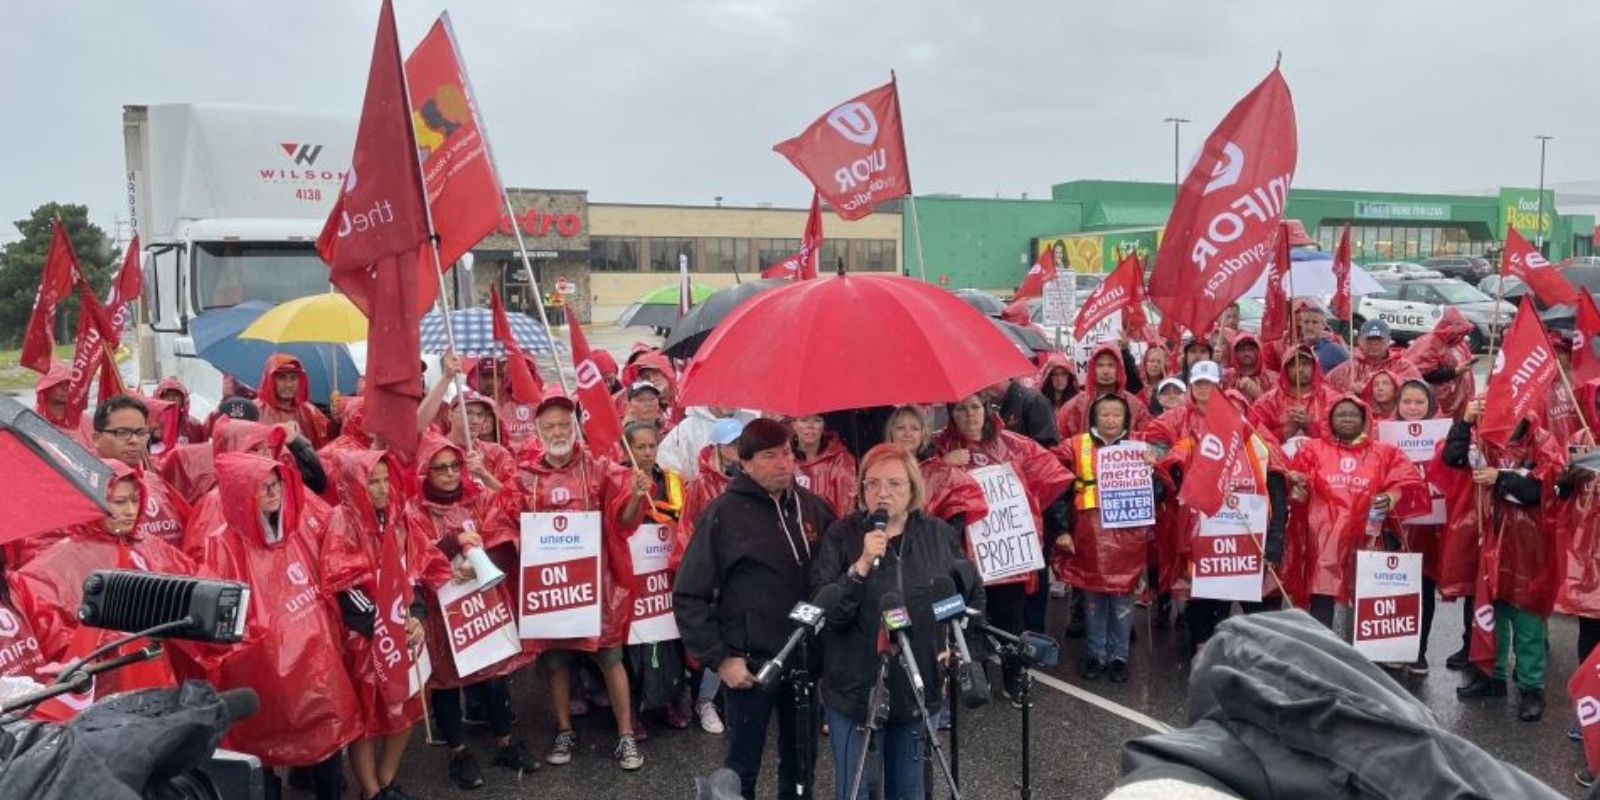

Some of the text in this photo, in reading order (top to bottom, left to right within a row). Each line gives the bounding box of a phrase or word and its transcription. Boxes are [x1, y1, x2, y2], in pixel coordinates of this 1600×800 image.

[296, 188, 321, 200] 4138
[1517, 197, 1540, 210] food
[501, 208, 582, 236] etro
[1379, 313, 1424, 326] POLICE
[1101, 450, 1145, 463] HONK
[1101, 468, 1149, 480] metro
[984, 473, 1021, 504] HARE
[1103, 496, 1151, 510] BETTER
[1104, 507, 1151, 521] WAGES
[646, 544, 672, 554] UNIFO
[976, 531, 1035, 573] PROFIT
[1213, 537, 1237, 553] ON
[1200, 555, 1258, 574] STRIKE
[541, 565, 568, 586] ON
[647, 573, 669, 592] ON
[461, 593, 485, 618] ON
[527, 583, 594, 611] STRIKE
[634, 594, 673, 616] STRI
[1374, 599, 1396, 616] ON
[454, 602, 510, 647] STRIKE
[1361, 616, 1416, 637] STRIKE
